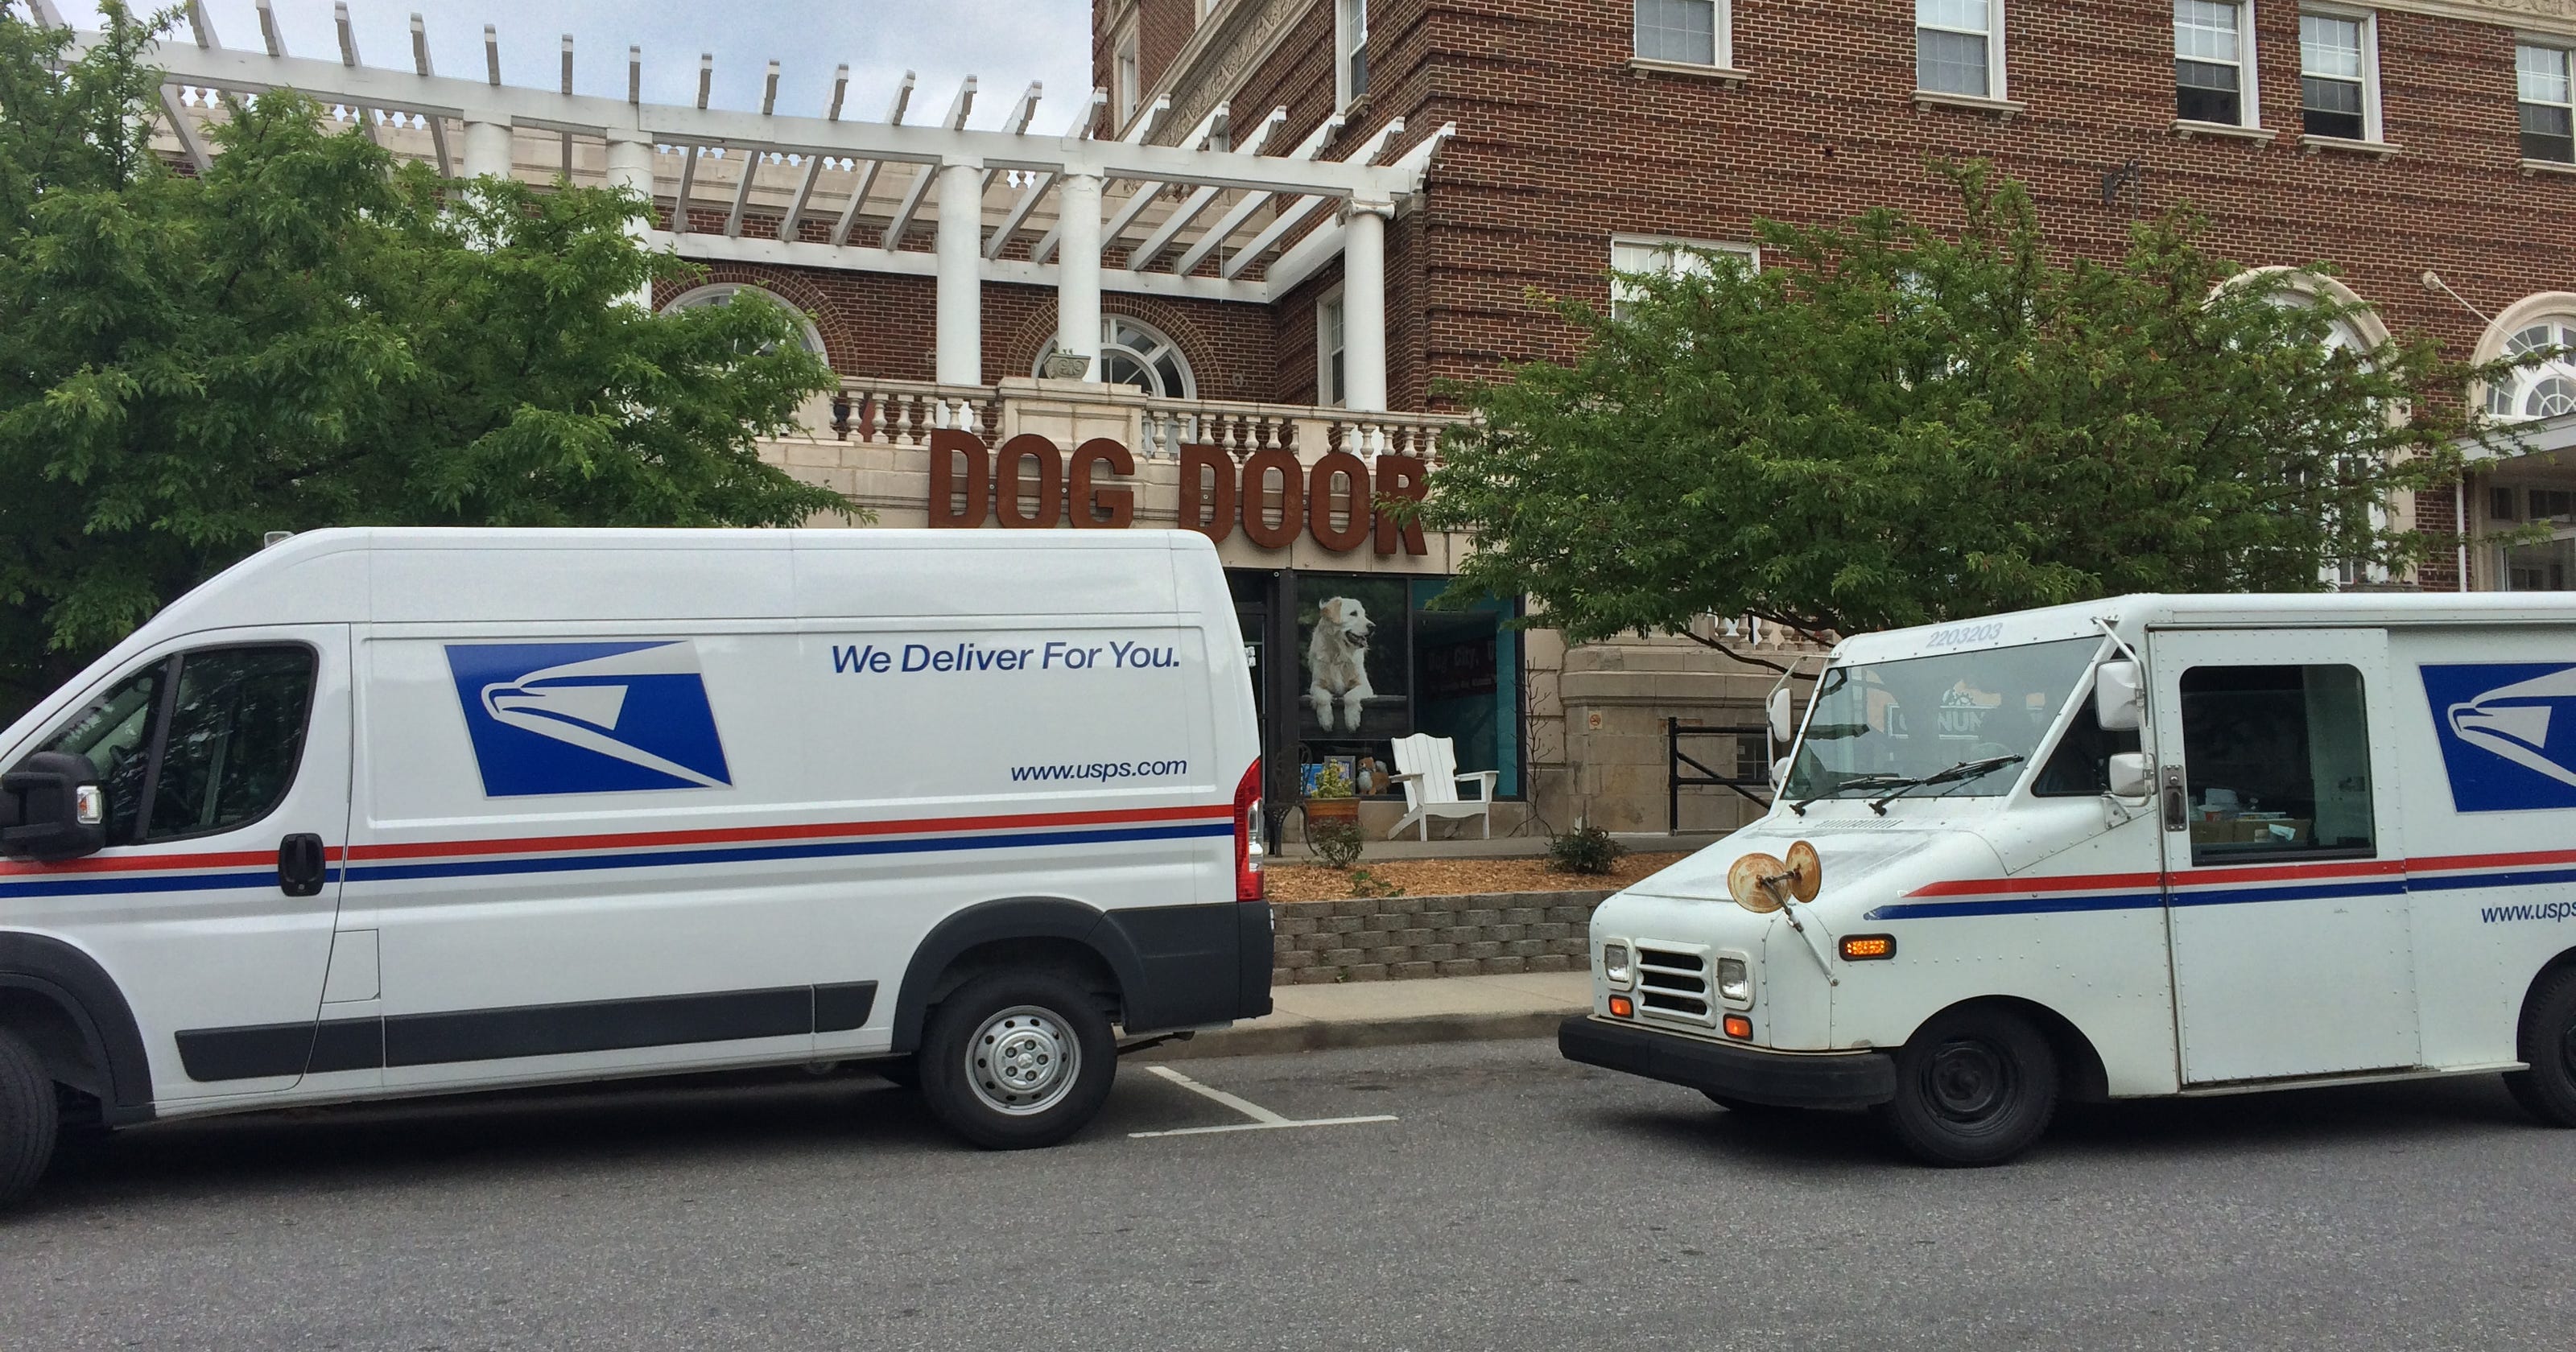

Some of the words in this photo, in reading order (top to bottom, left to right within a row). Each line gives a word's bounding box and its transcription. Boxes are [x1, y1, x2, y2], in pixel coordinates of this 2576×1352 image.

[929, 427, 1134, 529] DOG
[1179, 443, 1428, 555] DOOR
[1926, 622, 2003, 647] 2203203
[832, 645, 891, 673] We
[901, 643, 1034, 673] Deliver
[1042, 641, 1103, 670] For
[1110, 641, 1181, 668] You.
[1010, 759, 1187, 783] www.usps.com
